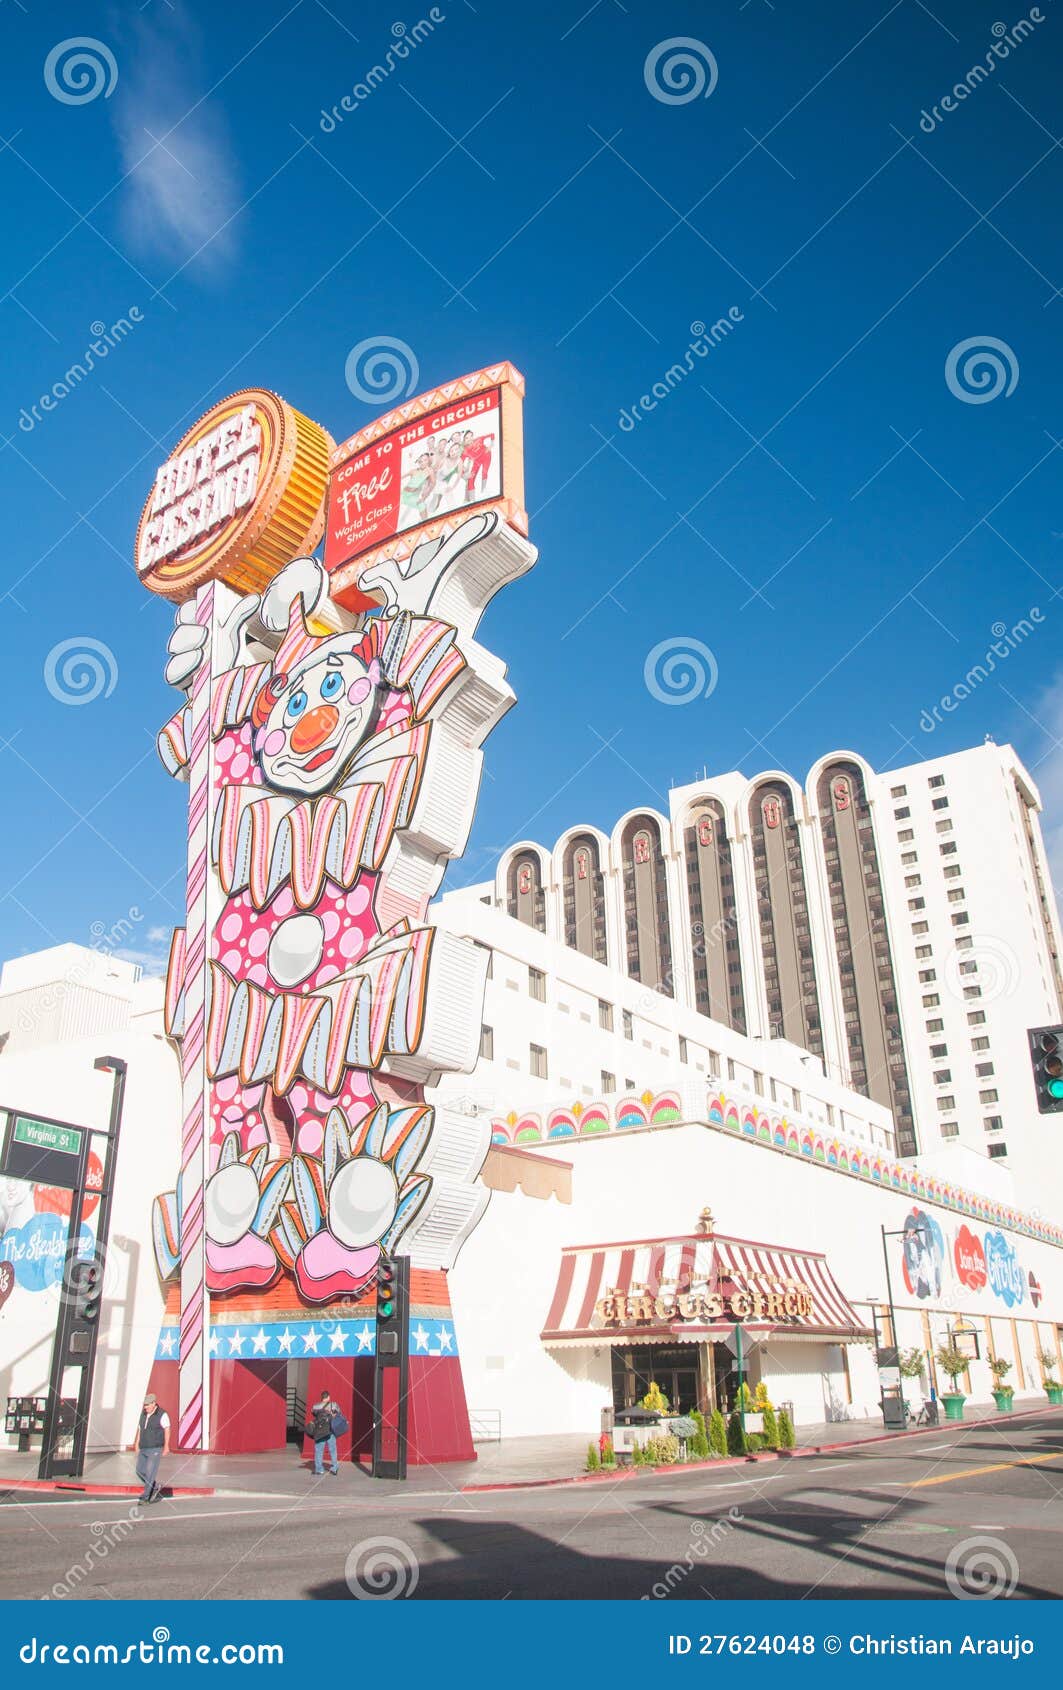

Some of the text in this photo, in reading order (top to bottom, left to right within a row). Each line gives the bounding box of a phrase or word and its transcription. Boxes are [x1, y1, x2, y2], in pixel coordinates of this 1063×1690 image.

[151, 402, 261, 517] HOTEL
[337, 397, 492, 482] COME TO THE CIRCUS!
[137, 452, 258, 572] CASINO
[336, 466, 393, 525] Free
[334, 503, 393, 540] World Class
[345, 522, 378, 546] Shows
[518, 780, 853, 895] CIRCUS
[26, 1126, 70, 1147] Virginia St
[3, 1228, 93, 1262] The Steakhse
[596, 1291, 815, 1322] CIRCUS CIRCUS
